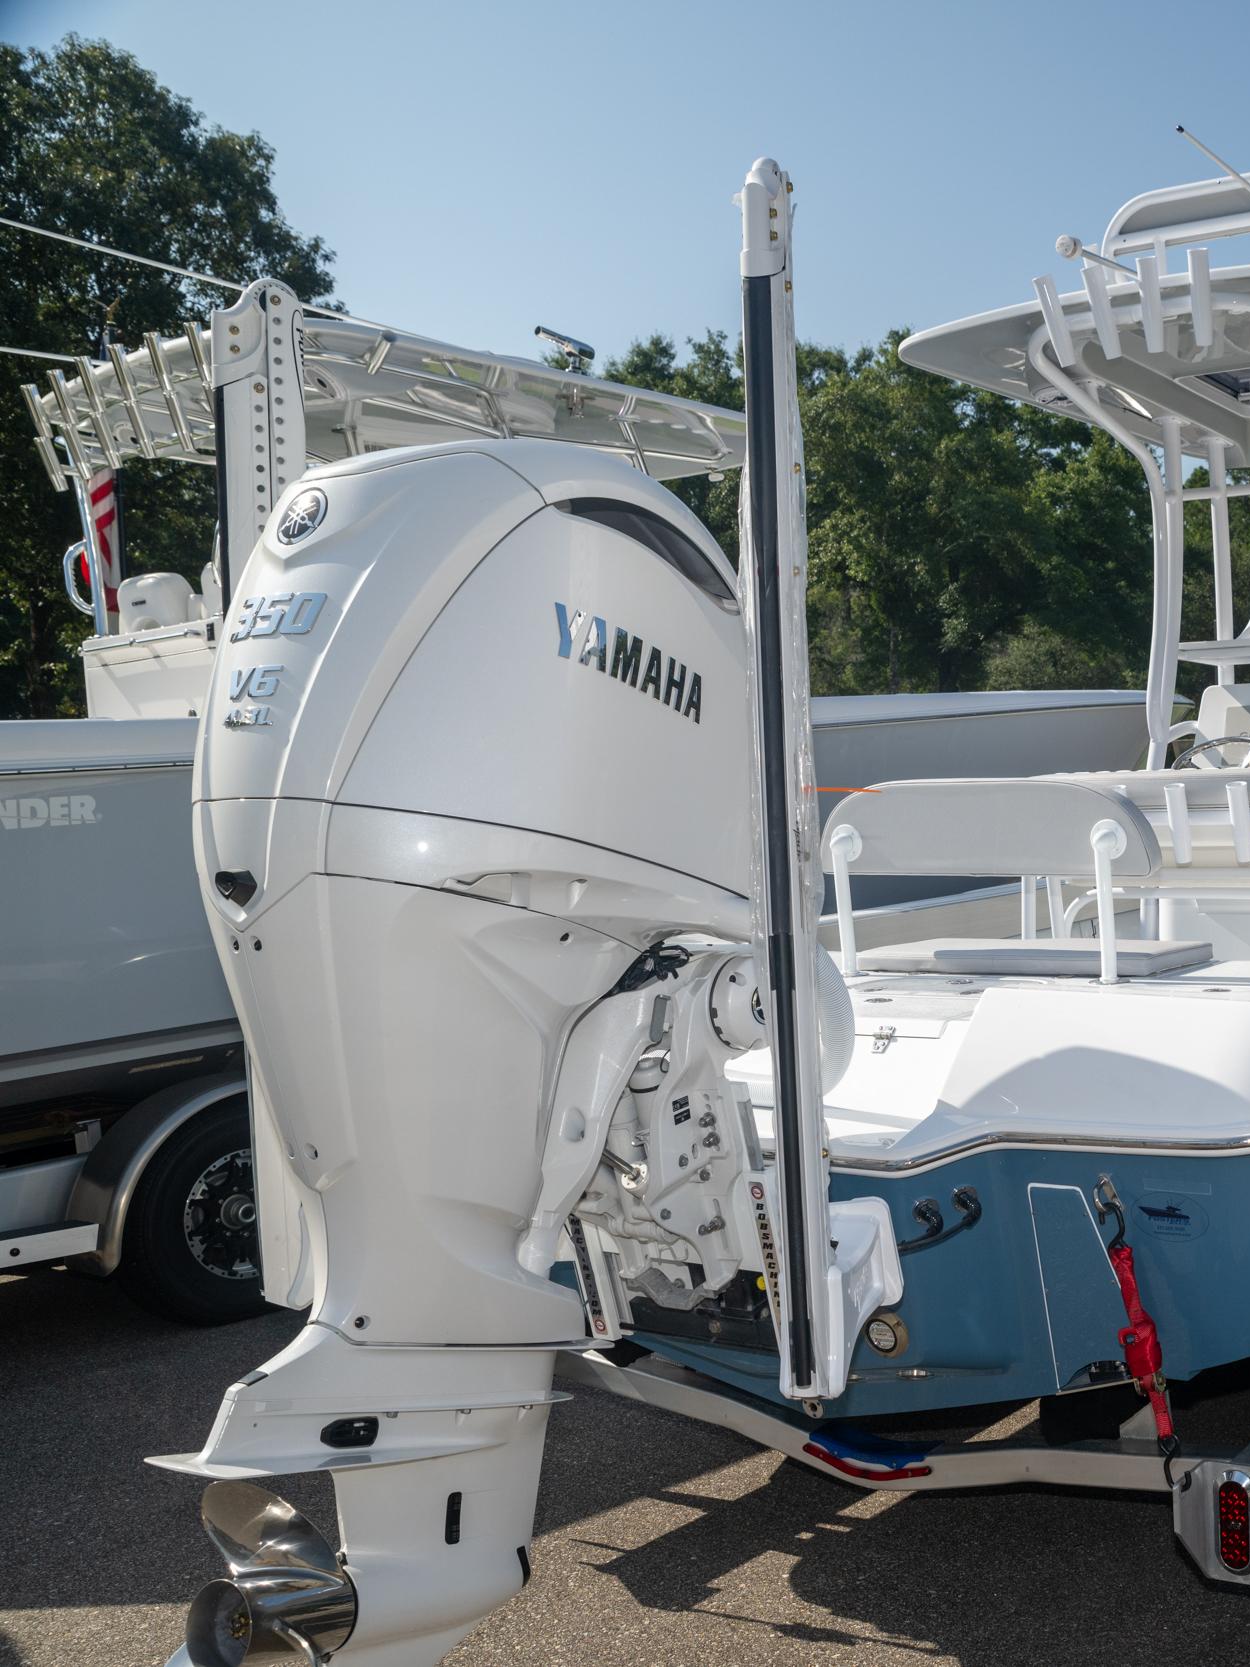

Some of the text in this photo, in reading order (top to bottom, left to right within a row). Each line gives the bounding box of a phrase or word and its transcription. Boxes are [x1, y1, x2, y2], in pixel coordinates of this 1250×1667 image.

[230, 592, 328, 643] 350
[229, 665, 284, 701] V6
[554, 602, 702, 725] YAMAHA
